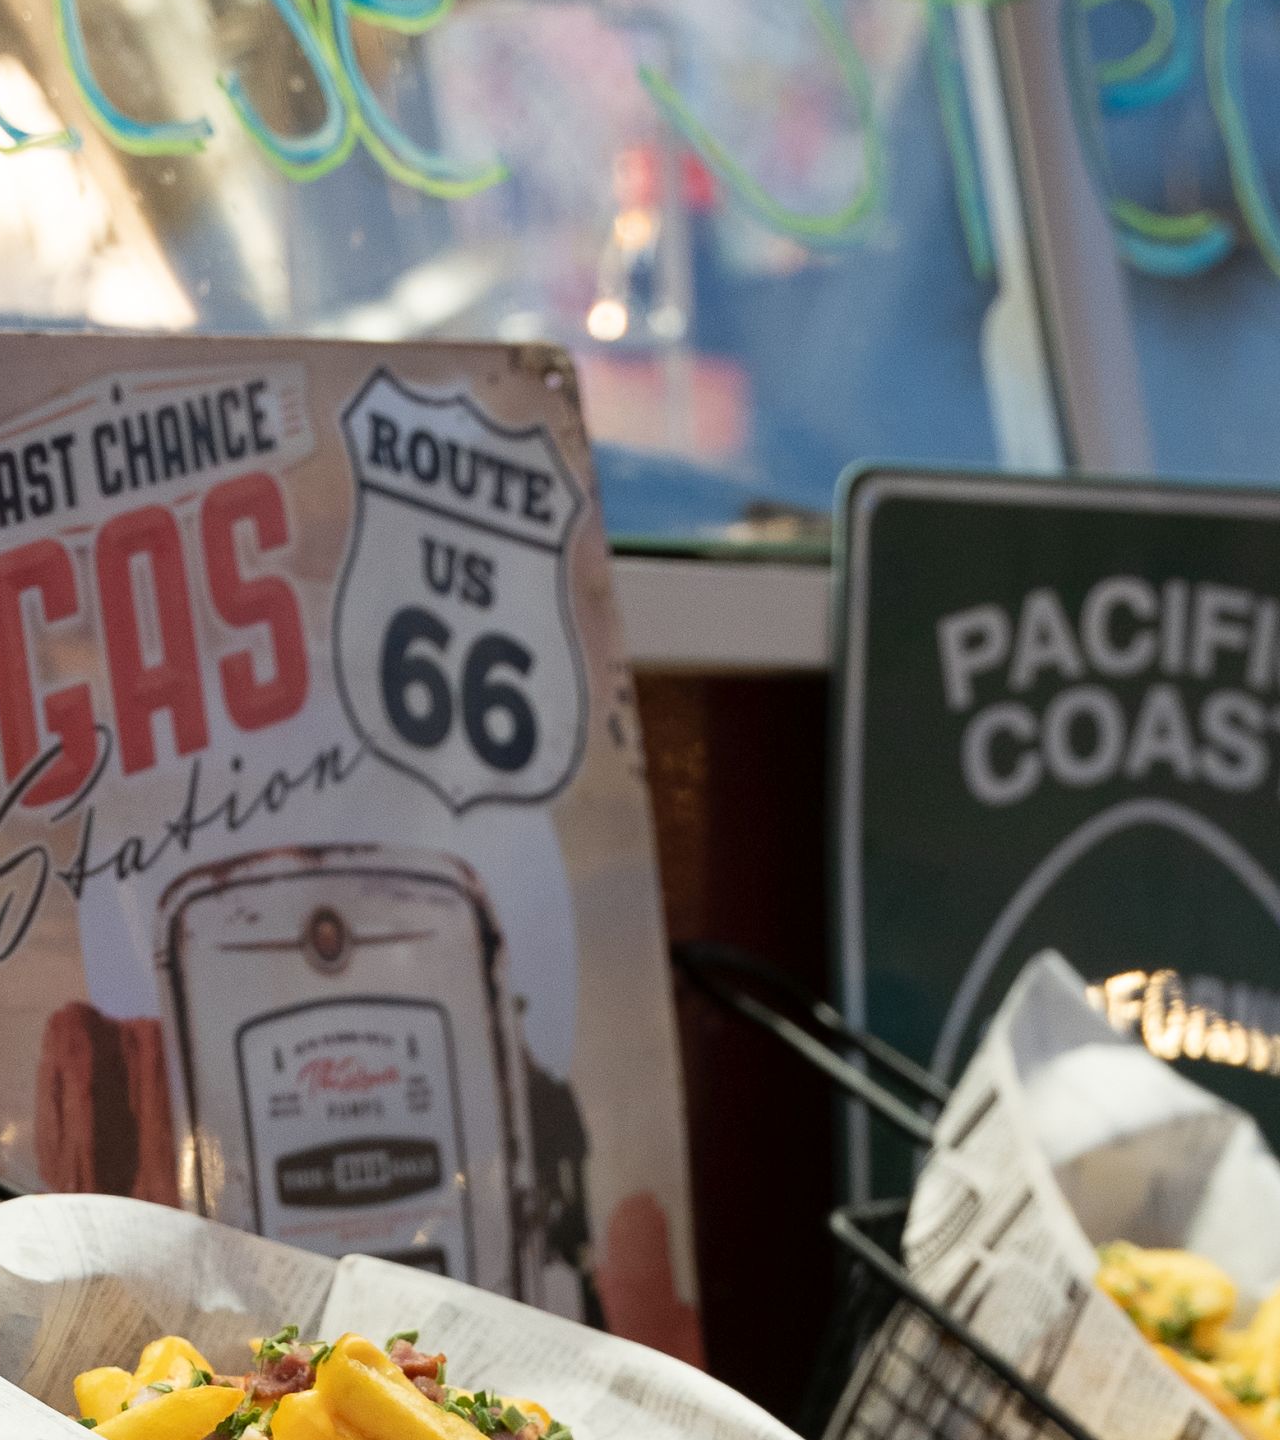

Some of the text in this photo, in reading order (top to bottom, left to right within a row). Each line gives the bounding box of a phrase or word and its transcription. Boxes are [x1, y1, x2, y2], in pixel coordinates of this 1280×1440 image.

[91, 379, 279, 498] CHANCE
[367, 411, 555, 526] ROUTE
[420, 536, 499, 613] US
[378, 603, 541, 775] 66
